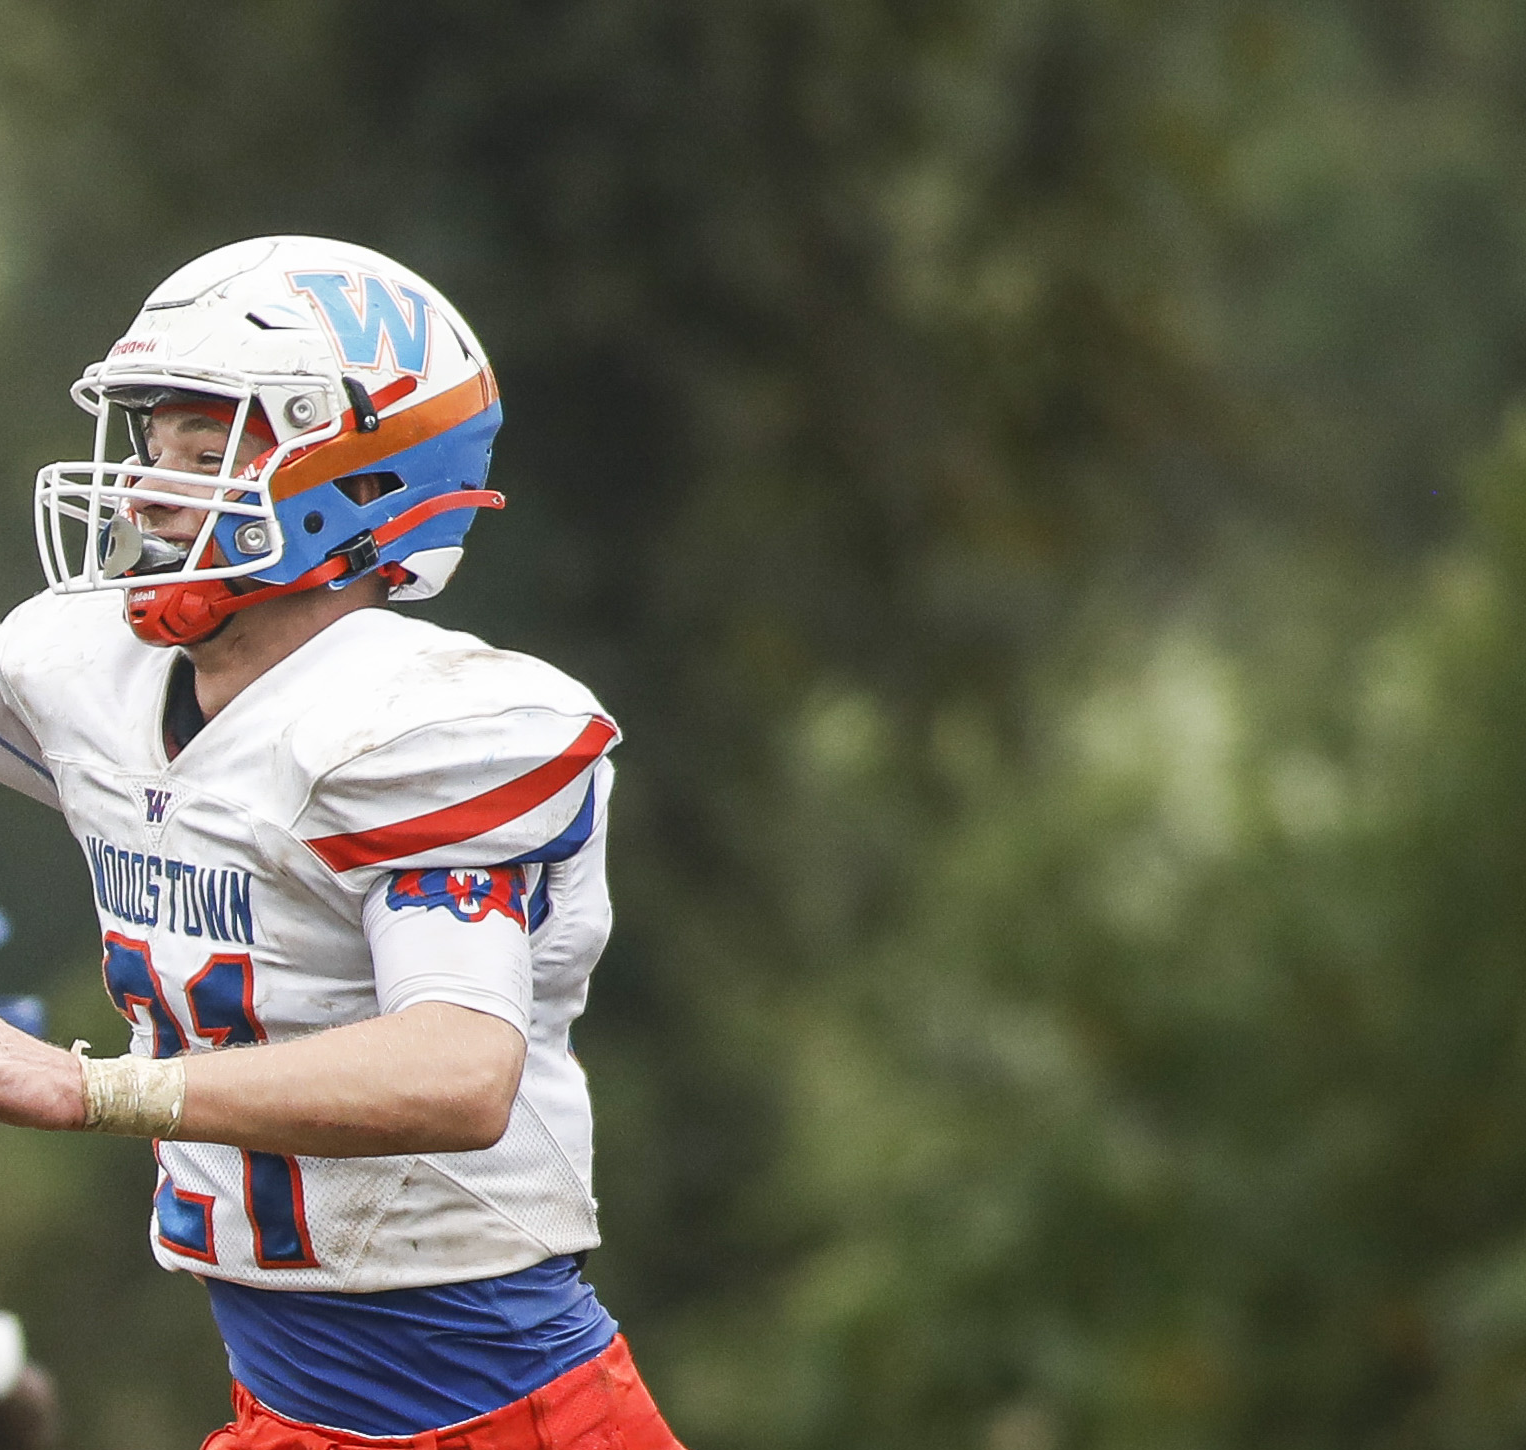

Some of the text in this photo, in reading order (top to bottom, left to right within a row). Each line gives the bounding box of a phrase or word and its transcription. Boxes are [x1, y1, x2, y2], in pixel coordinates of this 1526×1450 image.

[284, 269, 437, 380] W
[144, 787, 172, 823] W
[86, 835, 255, 945] WOODSTOWN
[102, 930, 320, 1269] 21
